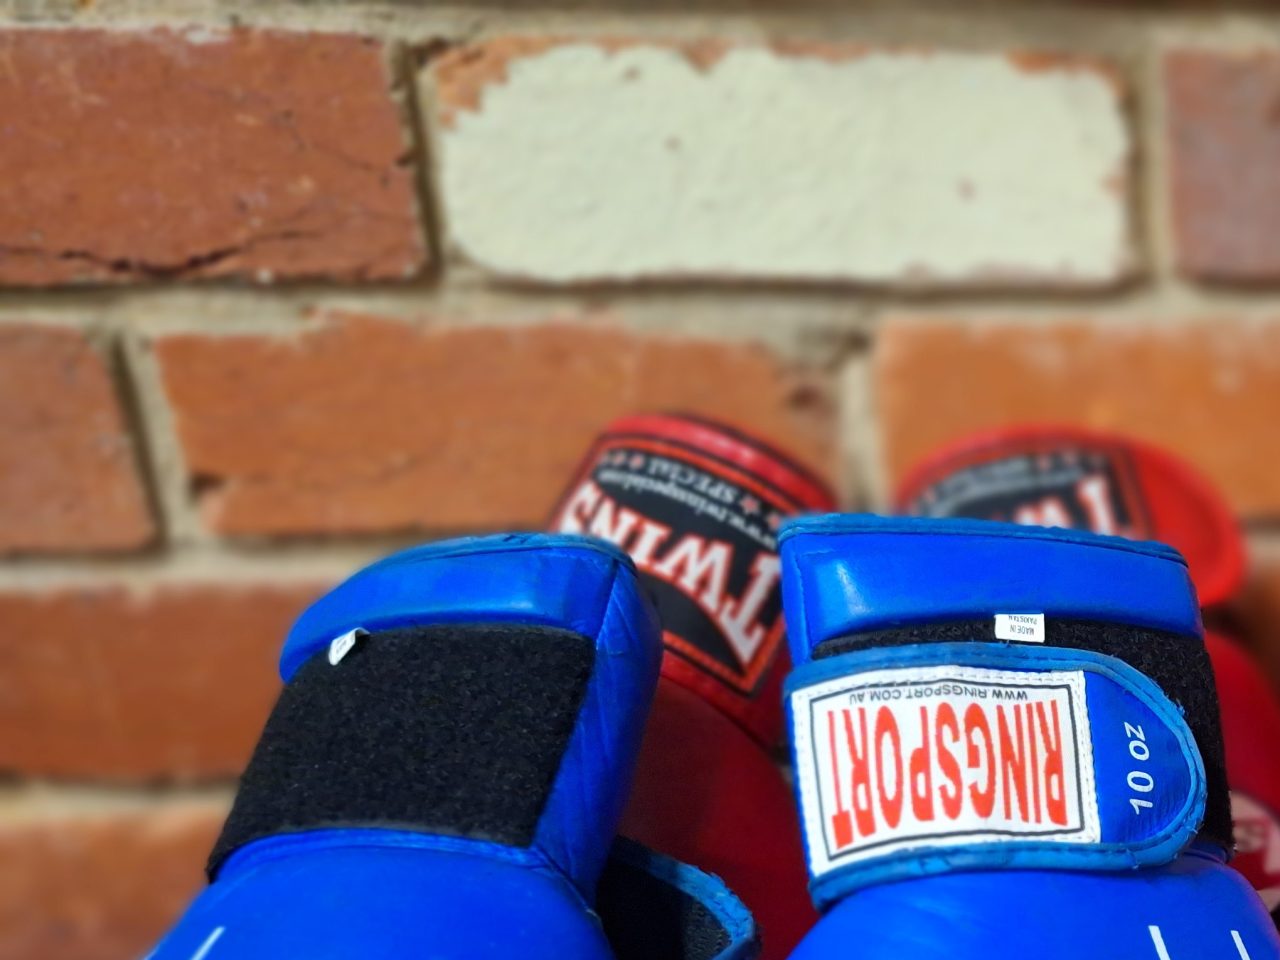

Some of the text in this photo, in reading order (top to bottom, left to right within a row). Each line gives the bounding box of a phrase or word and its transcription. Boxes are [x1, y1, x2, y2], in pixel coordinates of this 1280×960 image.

[559, 483, 781, 664] TWINS
[827, 699, 1068, 850] RINGSPORT
[1126, 770, 1154, 815] 10
